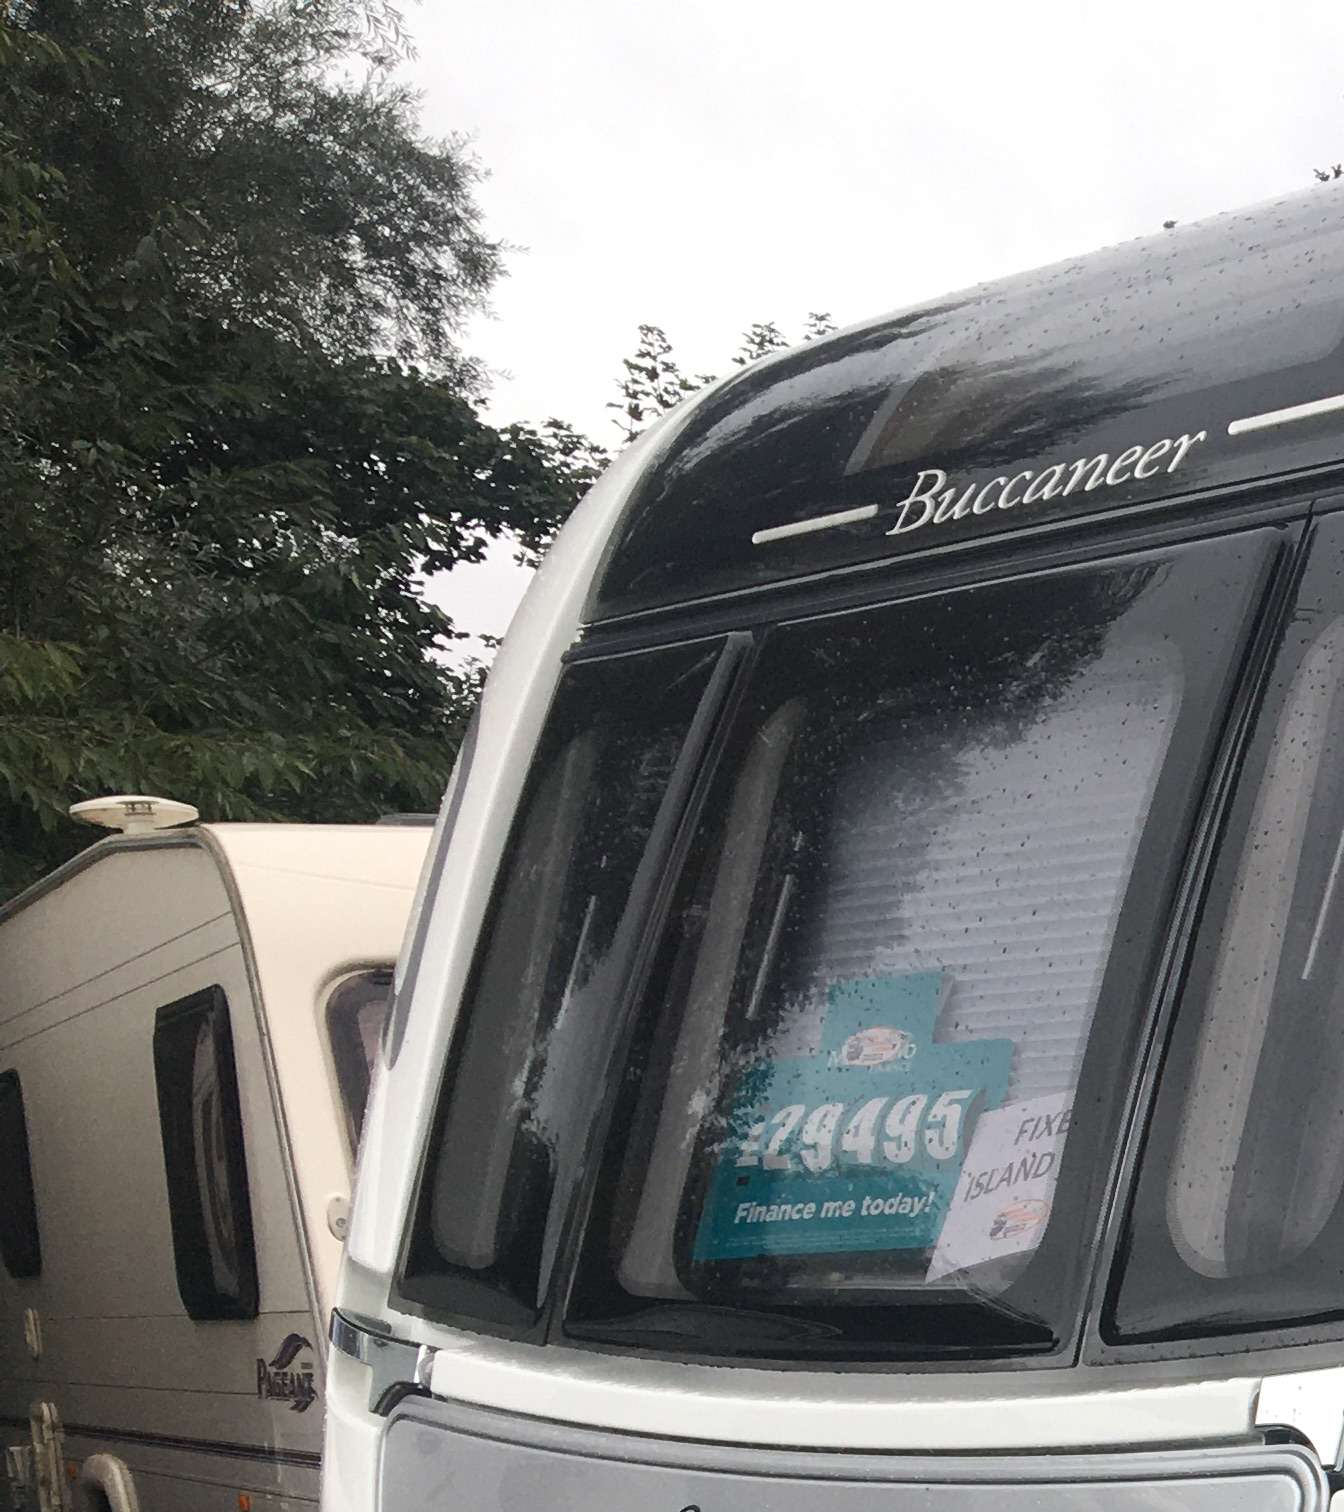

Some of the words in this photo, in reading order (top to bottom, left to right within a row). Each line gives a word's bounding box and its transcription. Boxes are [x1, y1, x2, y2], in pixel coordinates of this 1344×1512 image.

[886, 429, 1206, 537] Buccaneer
[964, 1152, 1056, 1203] ISLAND
[734, 1201, 817, 1224] Finance
[820, 1199, 856, 1218] me
[861, 1191, 935, 1218] today!
